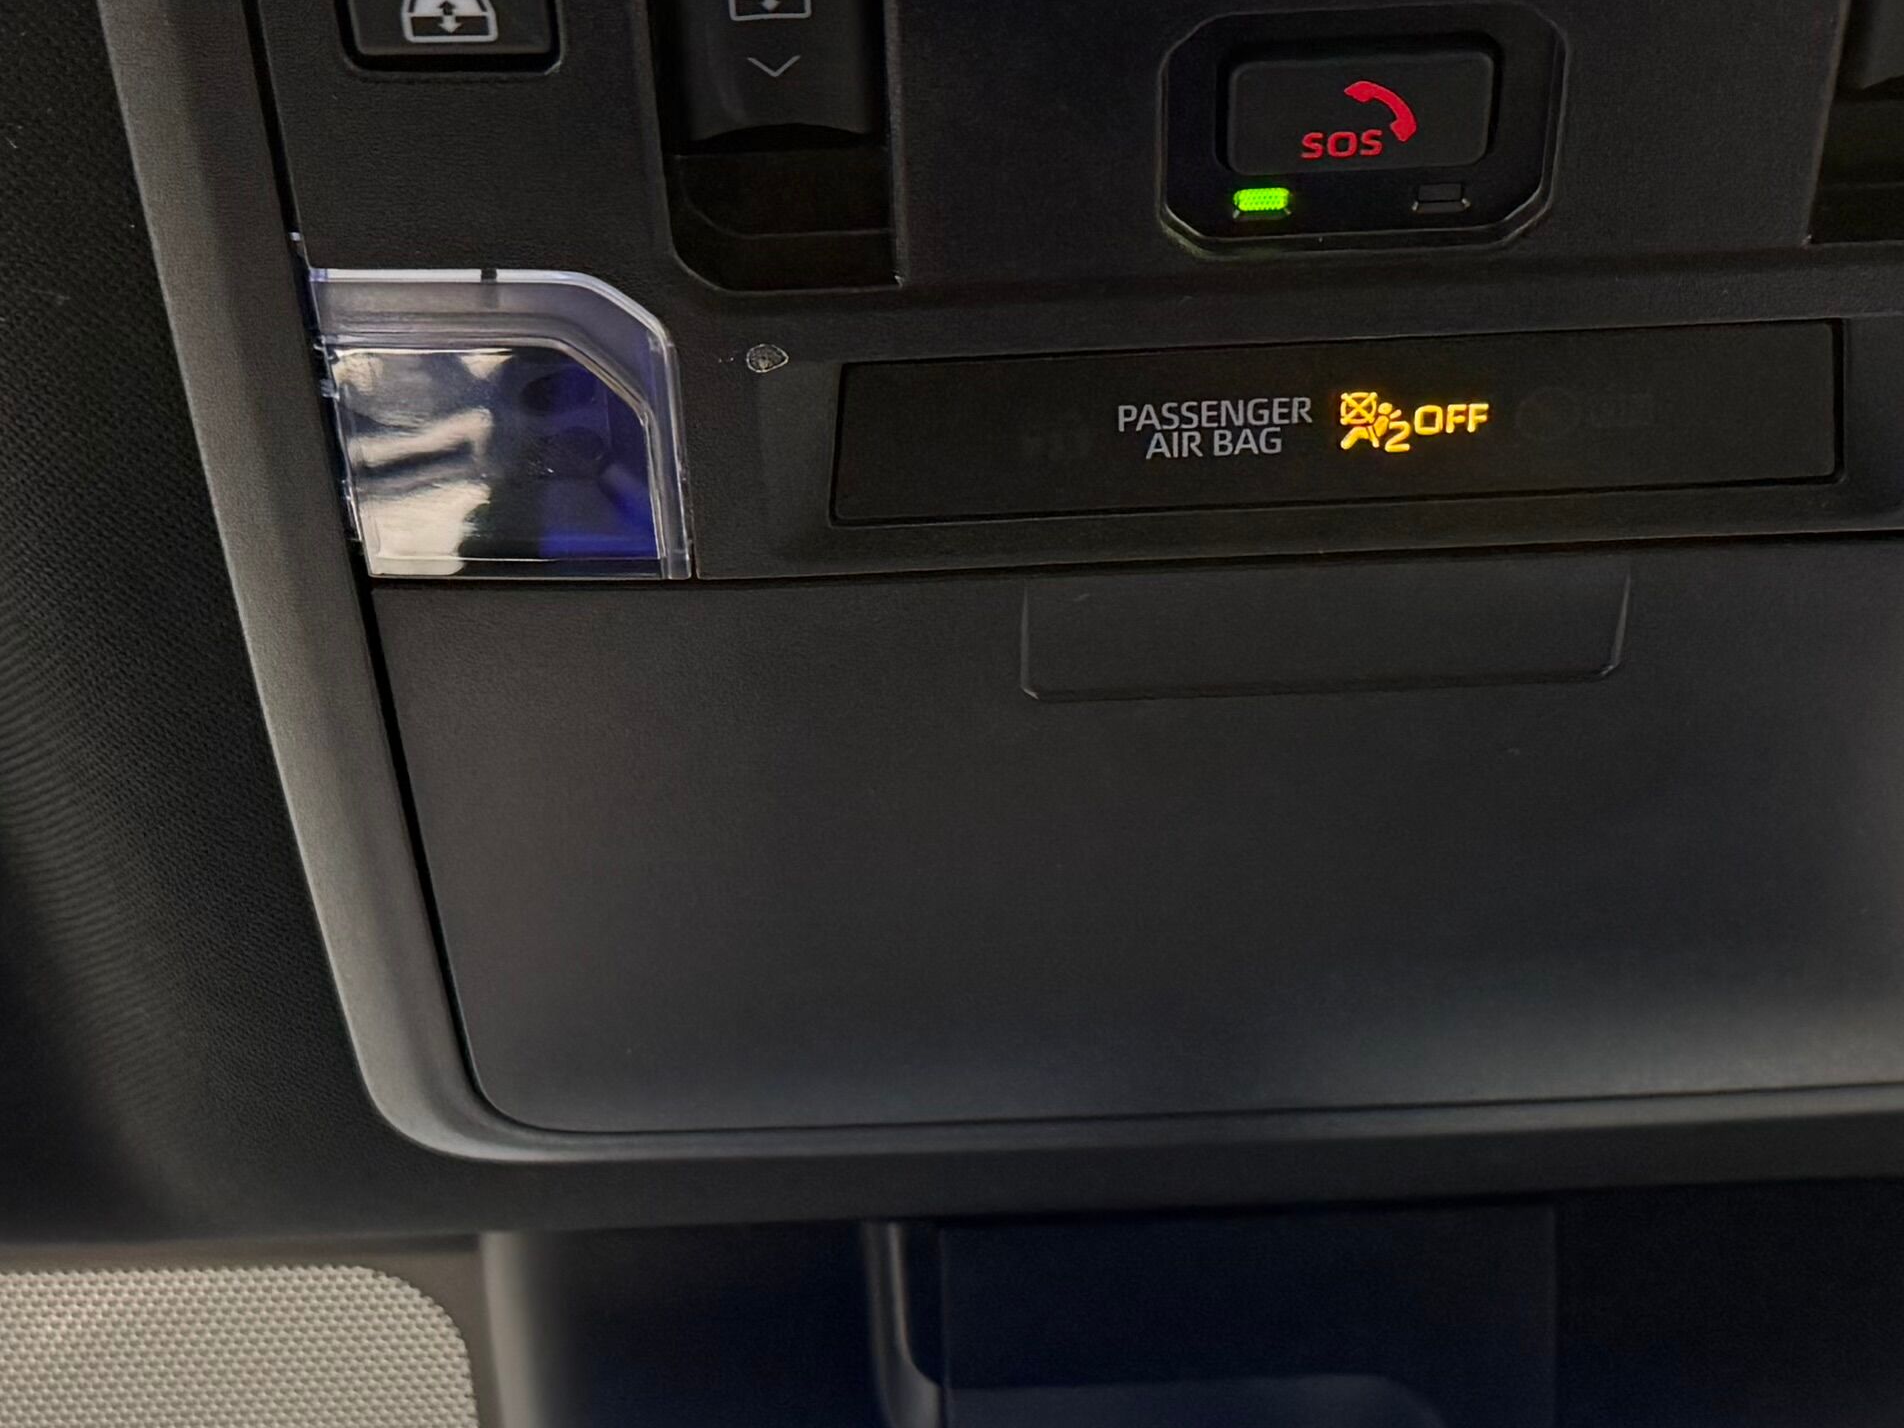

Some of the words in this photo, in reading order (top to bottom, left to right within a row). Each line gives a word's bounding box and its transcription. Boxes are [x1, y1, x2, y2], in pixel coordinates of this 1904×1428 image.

[1300, 129, 1383, 159] SOS
[1116, 397, 1314, 433] PASSENGER
[1412, 402, 1491, 436] OFF
[1144, 429, 1203, 461] AIR
[1213, 427, 1283, 457] BAG
